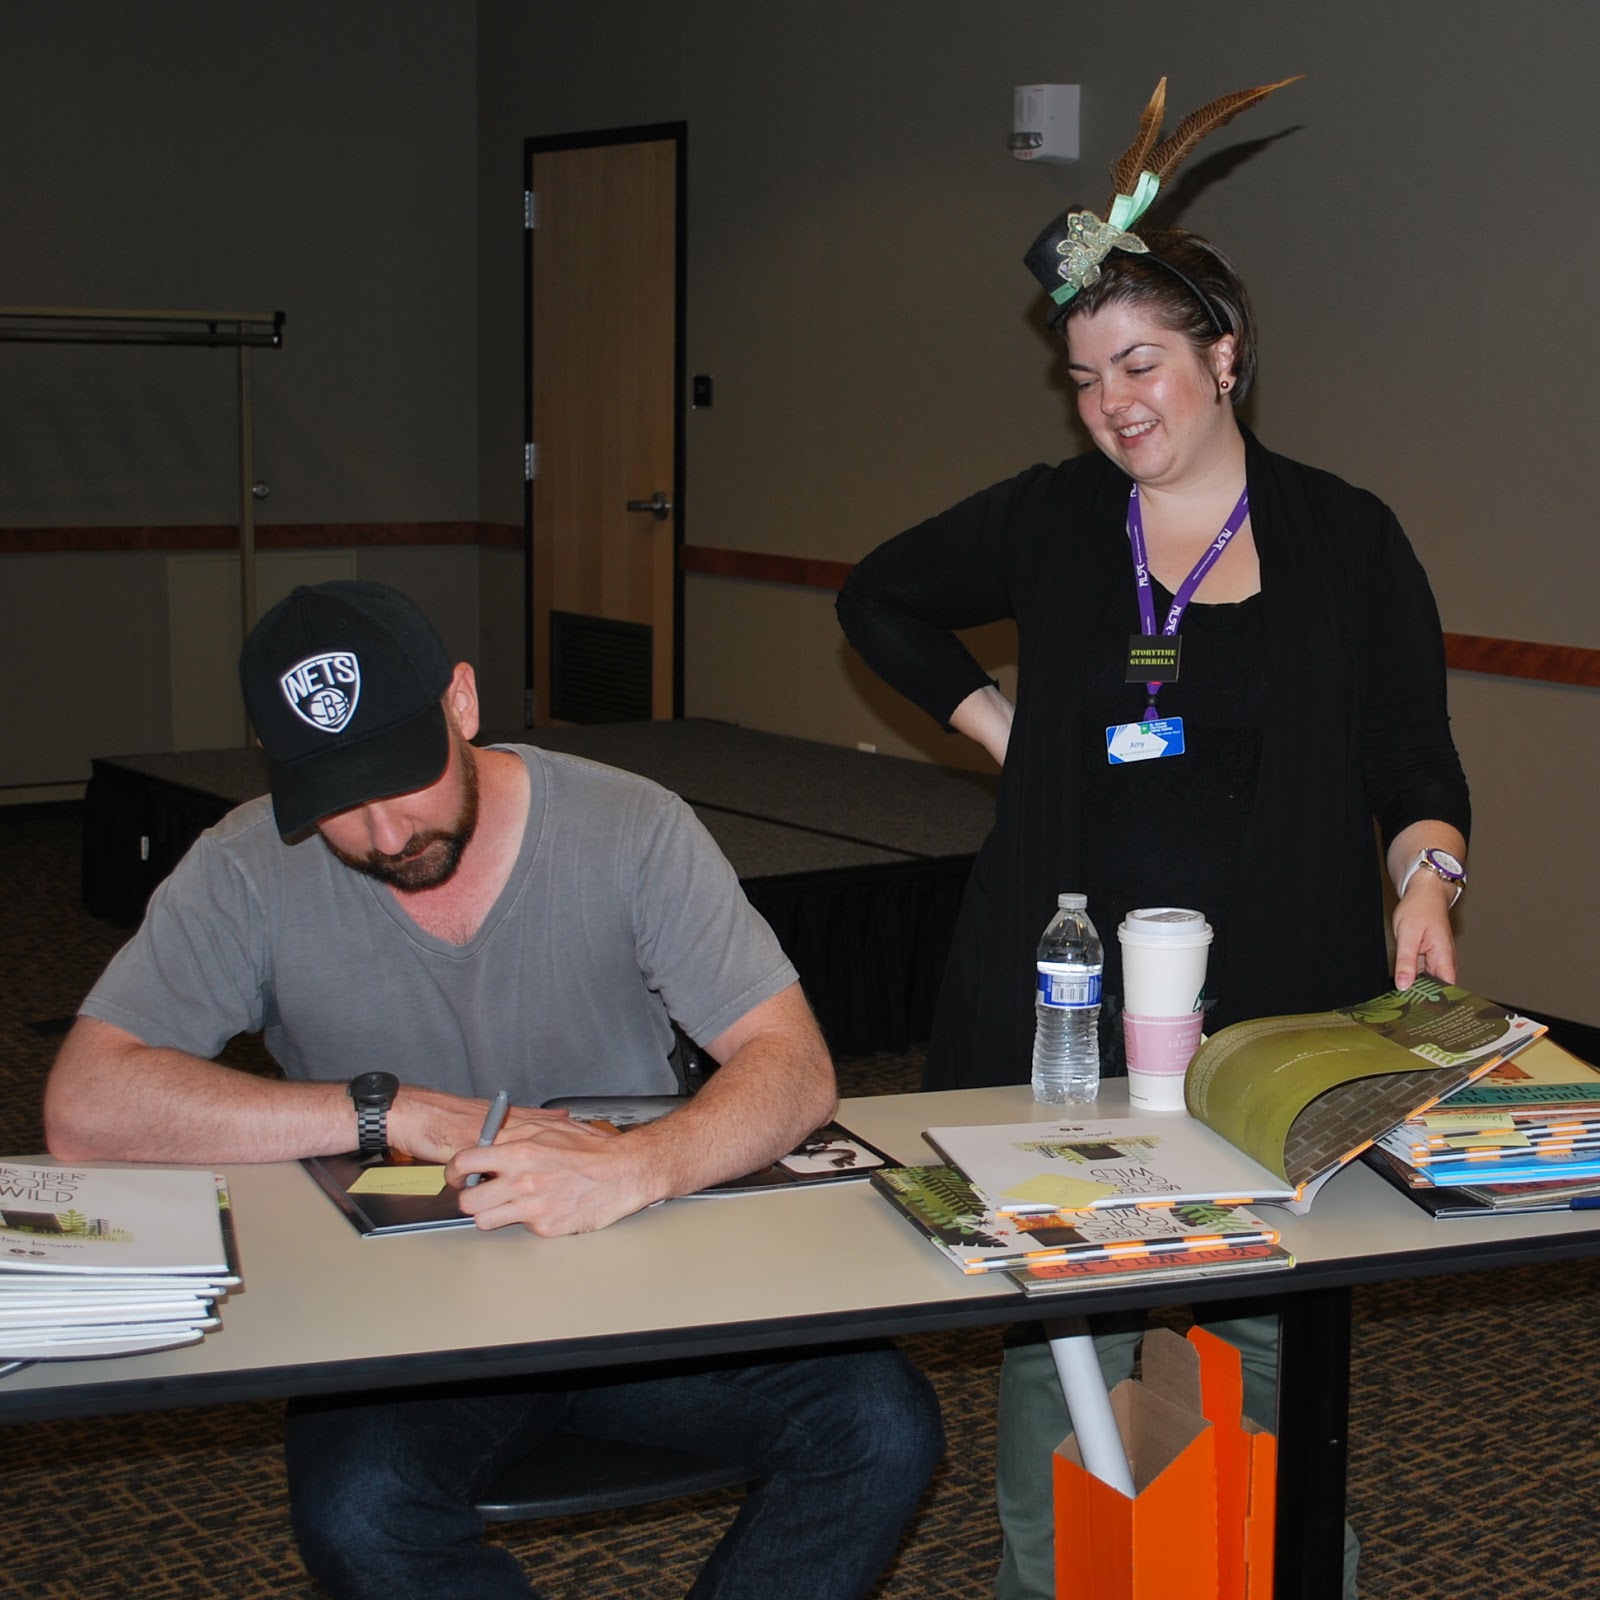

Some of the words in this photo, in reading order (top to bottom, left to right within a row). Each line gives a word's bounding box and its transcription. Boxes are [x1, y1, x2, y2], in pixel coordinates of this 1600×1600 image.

[1130, 648, 1177, 657] STORYTIME
[1130, 658, 1175, 666] GUERRILLA
[287, 656, 356, 704] NETS
[1129, 740, 1145, 750] Amy
[1483, 1084, 1584, 1097] Terrible
[30, 1170, 87, 1180] TIGER
[1089, 1166, 1153, 1179] WILD
[1083, 1215, 1170, 1231] GOES
[1091, 1228, 1145, 1240] TIGER
[31, 1240, 84, 1249] brown
[1042, 1263, 1097, 1276] BE
